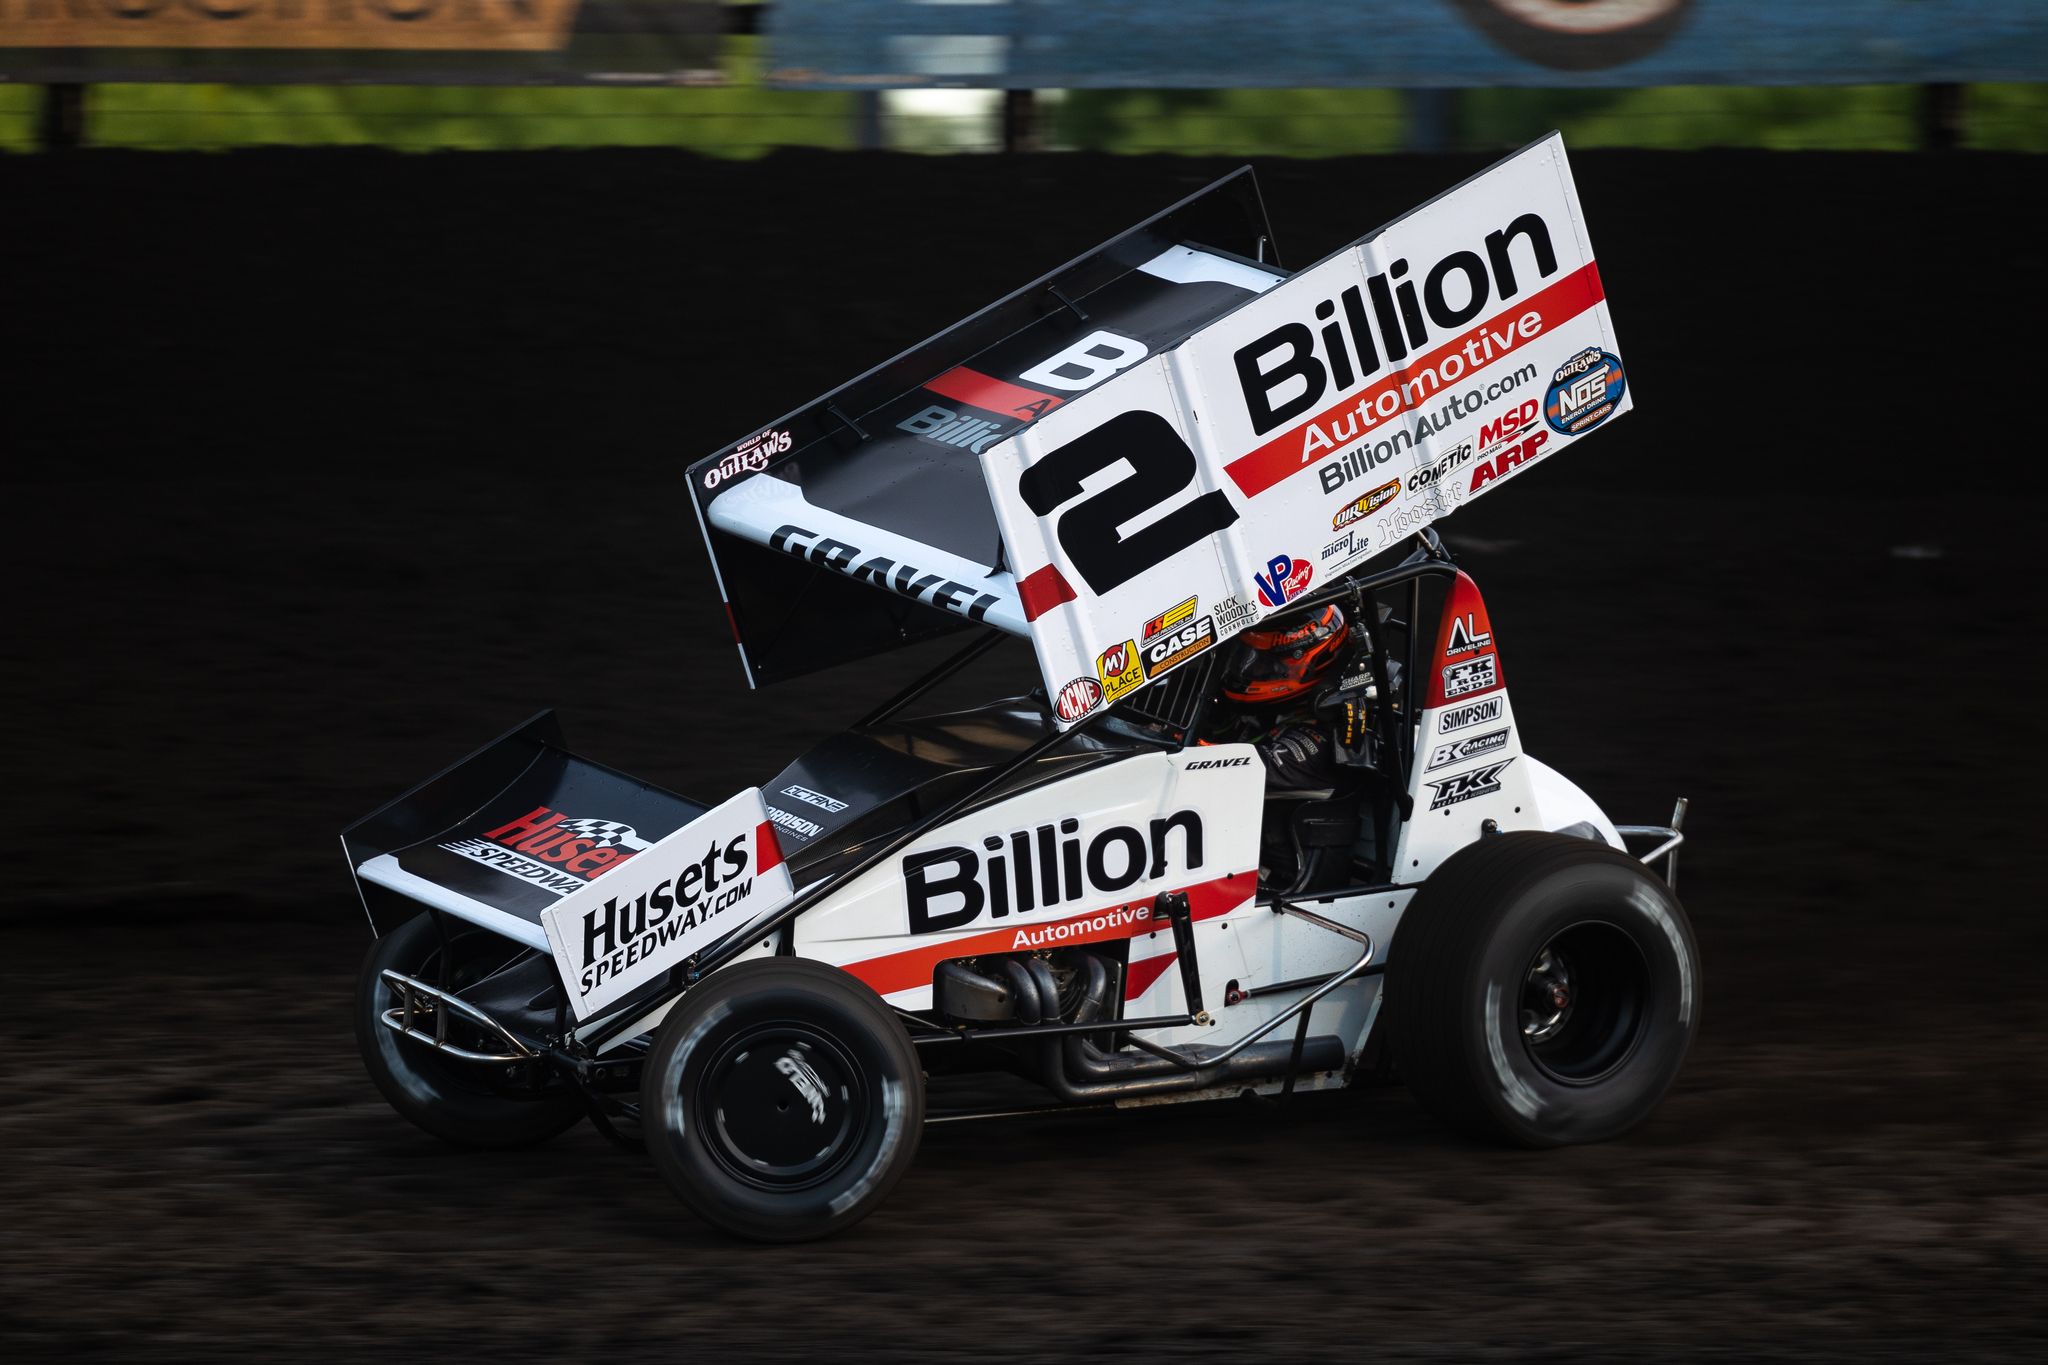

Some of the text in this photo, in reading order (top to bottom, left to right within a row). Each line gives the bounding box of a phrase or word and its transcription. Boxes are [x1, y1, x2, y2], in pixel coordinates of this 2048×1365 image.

[1233, 213, 1558, 436] Billion
[1555, 350, 1602, 382] OUTLAWS
[1300, 311, 1543, 464] Automotive
[1559, 366, 1607, 417] NOS
[1479, 399, 1539, 450] MSD
[1561, 396, 1606, 424] ENERGY DRINK
[1571, 403, 1612, 432] SPRINT CARS
[736, 428, 771, 452] WORLD OF
[704, 431, 793, 489] OUTLAWS
[1408, 444, 1472, 491] COMETIC
[1469, 430, 1549, 493] ARP
[1018, 410, 1239, 597] 2
[1377, 481, 1463, 548] Hoosier
[1253, 554, 1292, 606] VP
[1284, 563, 1312, 595] Racing
[1213, 596, 1239, 616] SLICK
[1216, 600, 1257, 626] WOODY'S
[1151, 617, 1211, 663] CASE
[1220, 616, 1255, 637] CORNHOLE
[1103, 643, 1126, 679] MY
[1160, 638, 1210, 669] CONSTRUCTION
[1446, 639, 1492, 656] DRIVELINE
[1105, 667, 1141, 697] PLACE
[1451, 659, 1493, 680] FK
[1456, 672, 1493, 686] ROD
[1061, 680, 1098, 719] ACME
[1446, 678, 1494, 696] ENDS
[1443, 699, 1498, 731] SIMPSON
[1463, 733, 1506, 752] RACING
[1185, 757, 1251, 770] GRAVEL
[902, 809, 1203, 935] Billion
[582, 833, 748, 970] Husets
[580, 877, 753, 997] SPEEDWAY.COM
[1012, 904, 1149, 949] Automotive
